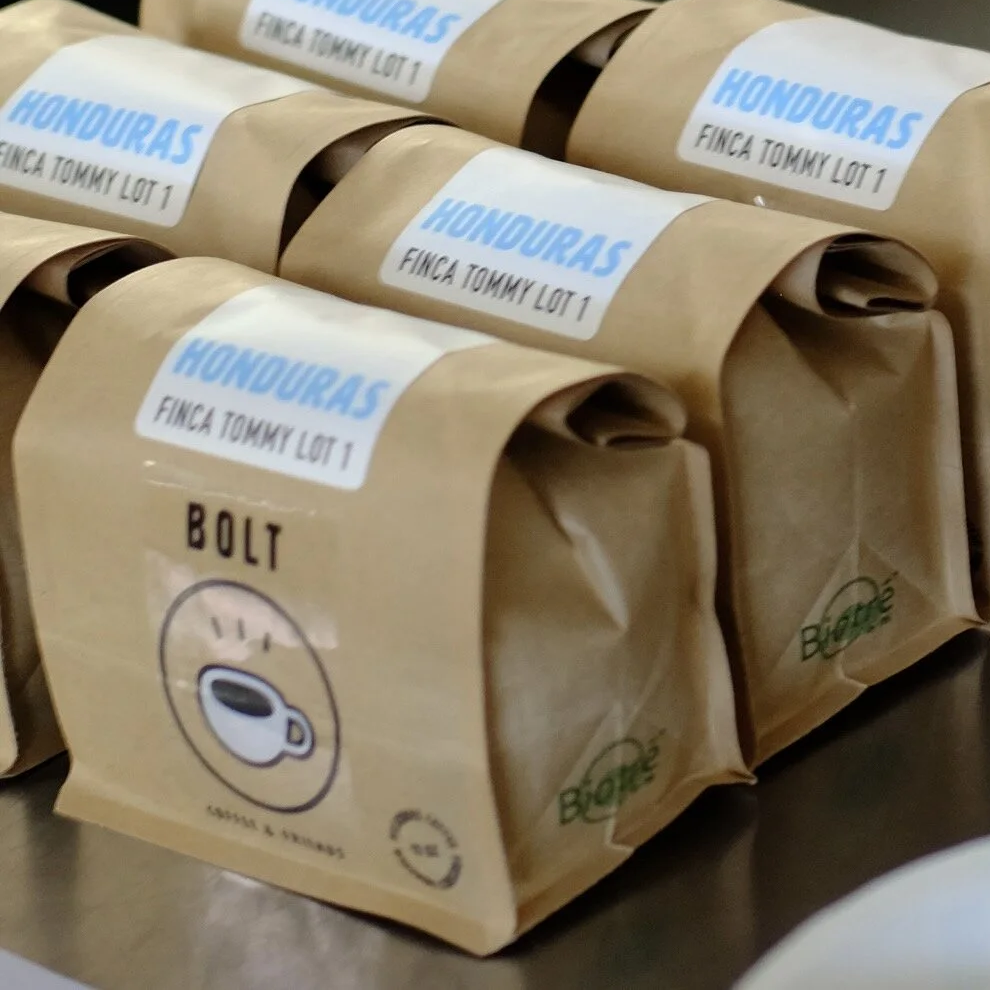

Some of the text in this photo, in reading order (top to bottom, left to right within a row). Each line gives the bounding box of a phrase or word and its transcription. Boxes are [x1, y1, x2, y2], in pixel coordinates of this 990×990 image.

[254, 12, 422, 86] FINCA TOMMY LOT 1
[8, 89, 203, 165] HONDURAS
[712, 67, 923, 150] HONDURAS
[51, 154, 119, 196] TOMMY
[118, 173, 158, 206] LOT
[159, 184, 173, 212] 1
[694, 123, 888, 194] FINCA TOMMY LOT 1
[420, 197, 632, 277] HONDURAS
[399, 247, 592, 322] FINCA TOMMY LOT 1
[173, 337, 391, 420] HONDURAS
[153, 394, 354, 471] FINCA TOMMY LOT 1
[187, 501, 283, 572] BOLT
